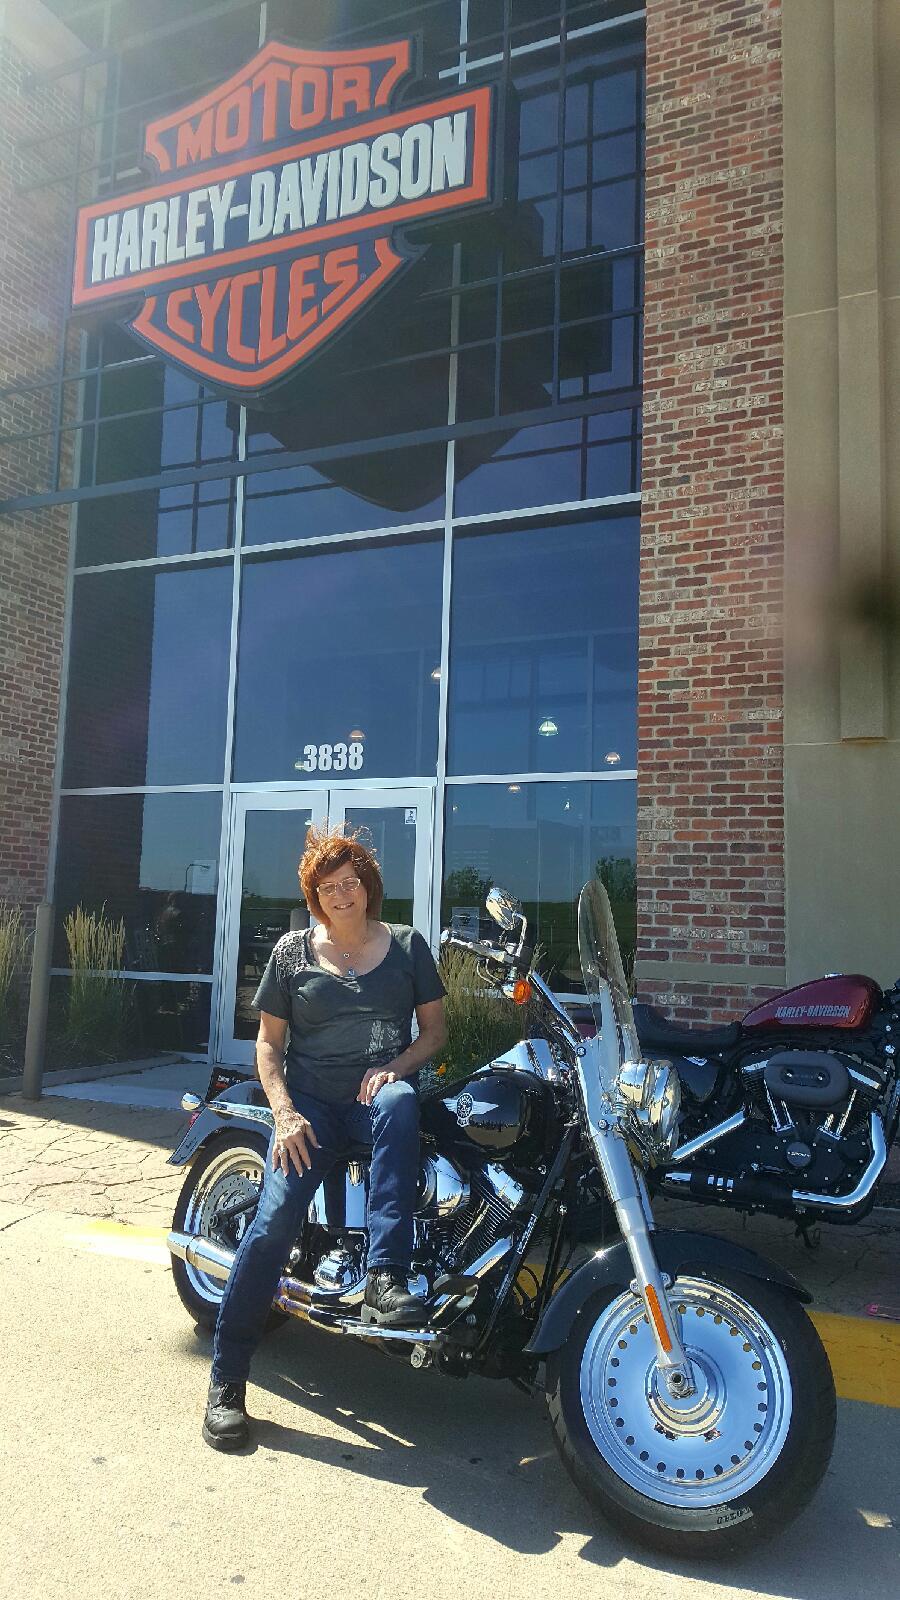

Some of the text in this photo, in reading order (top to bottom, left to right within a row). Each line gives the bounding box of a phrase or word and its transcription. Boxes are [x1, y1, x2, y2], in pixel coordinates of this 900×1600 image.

[176, 65, 370, 168] MOTOR
[91, 111, 468, 283] HARLEY-DAVIDSON
[166, 245, 359, 364] CYCLES
[303, 742, 364, 772] 3838
[775, 1005, 851, 1018] HARLEY-DAVIDSON
